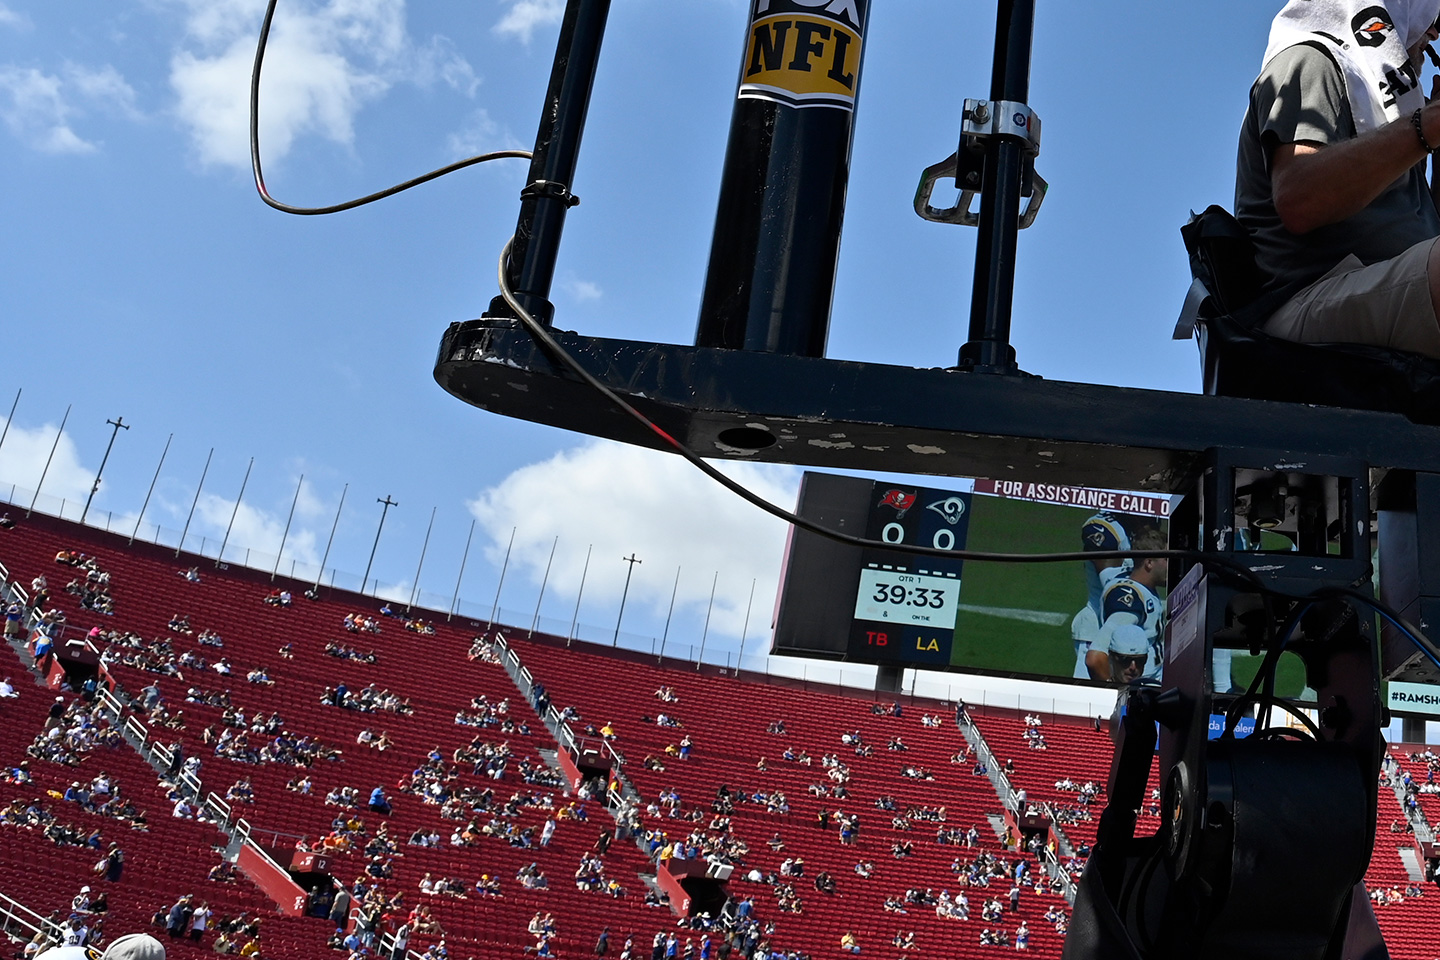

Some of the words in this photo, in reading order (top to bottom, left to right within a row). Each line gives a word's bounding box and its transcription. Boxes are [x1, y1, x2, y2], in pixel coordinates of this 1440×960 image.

[747, 21, 854, 91] NFL
[994, 480, 1023, 497] FOR
[1026, 483, 1115, 509] ASSISTANCE
[1120, 495, 1156, 514] CALL
[882, 522, 905, 545] 0
[933, 529, 956, 551] 0
[873, 583, 945, 609] 39:33
[866, 631, 888, 647] TB
[916, 637, 940, 652] LA
